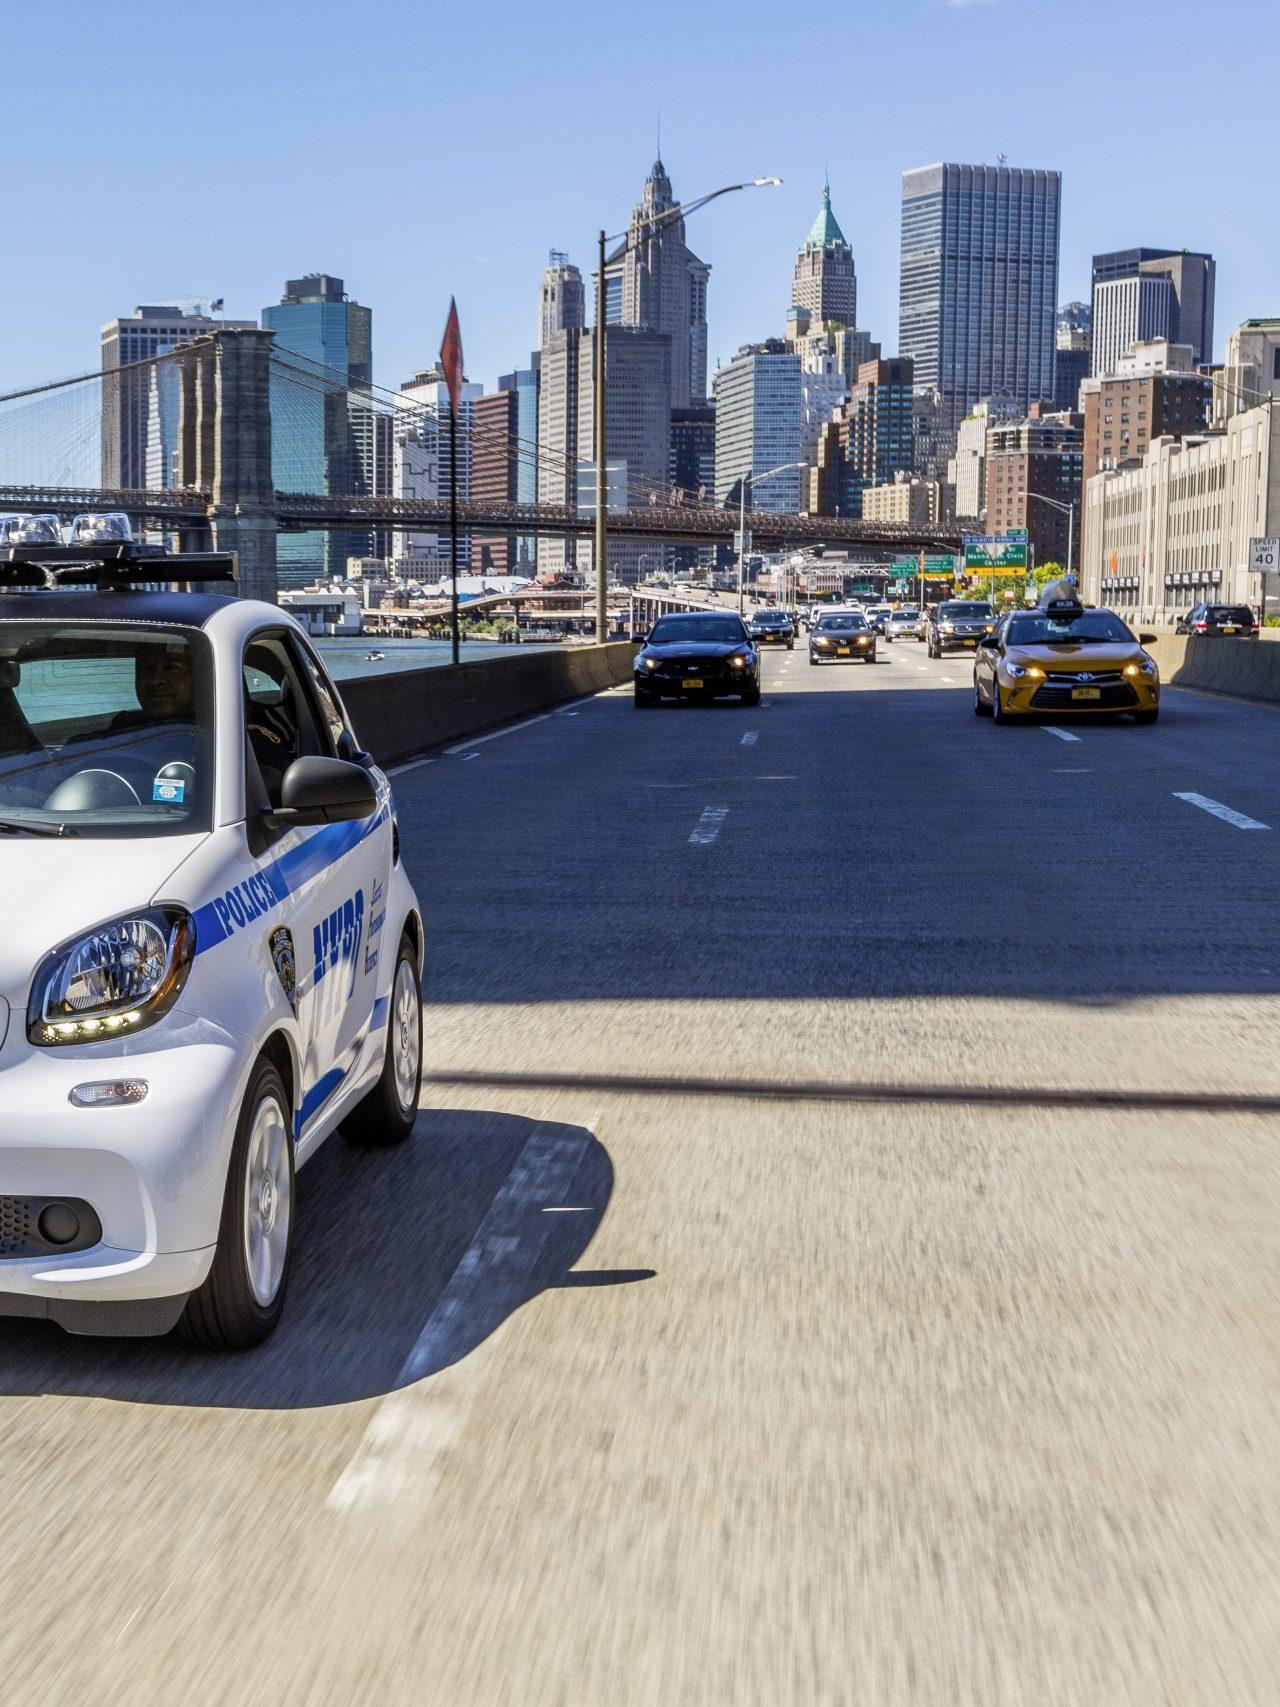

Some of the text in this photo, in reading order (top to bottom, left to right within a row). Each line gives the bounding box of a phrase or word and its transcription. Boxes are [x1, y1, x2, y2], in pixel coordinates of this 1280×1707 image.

[1254, 537, 1277, 545] SPEED
[1255, 553, 1273, 565] 40
[213, 870, 278, 937] POLICE
